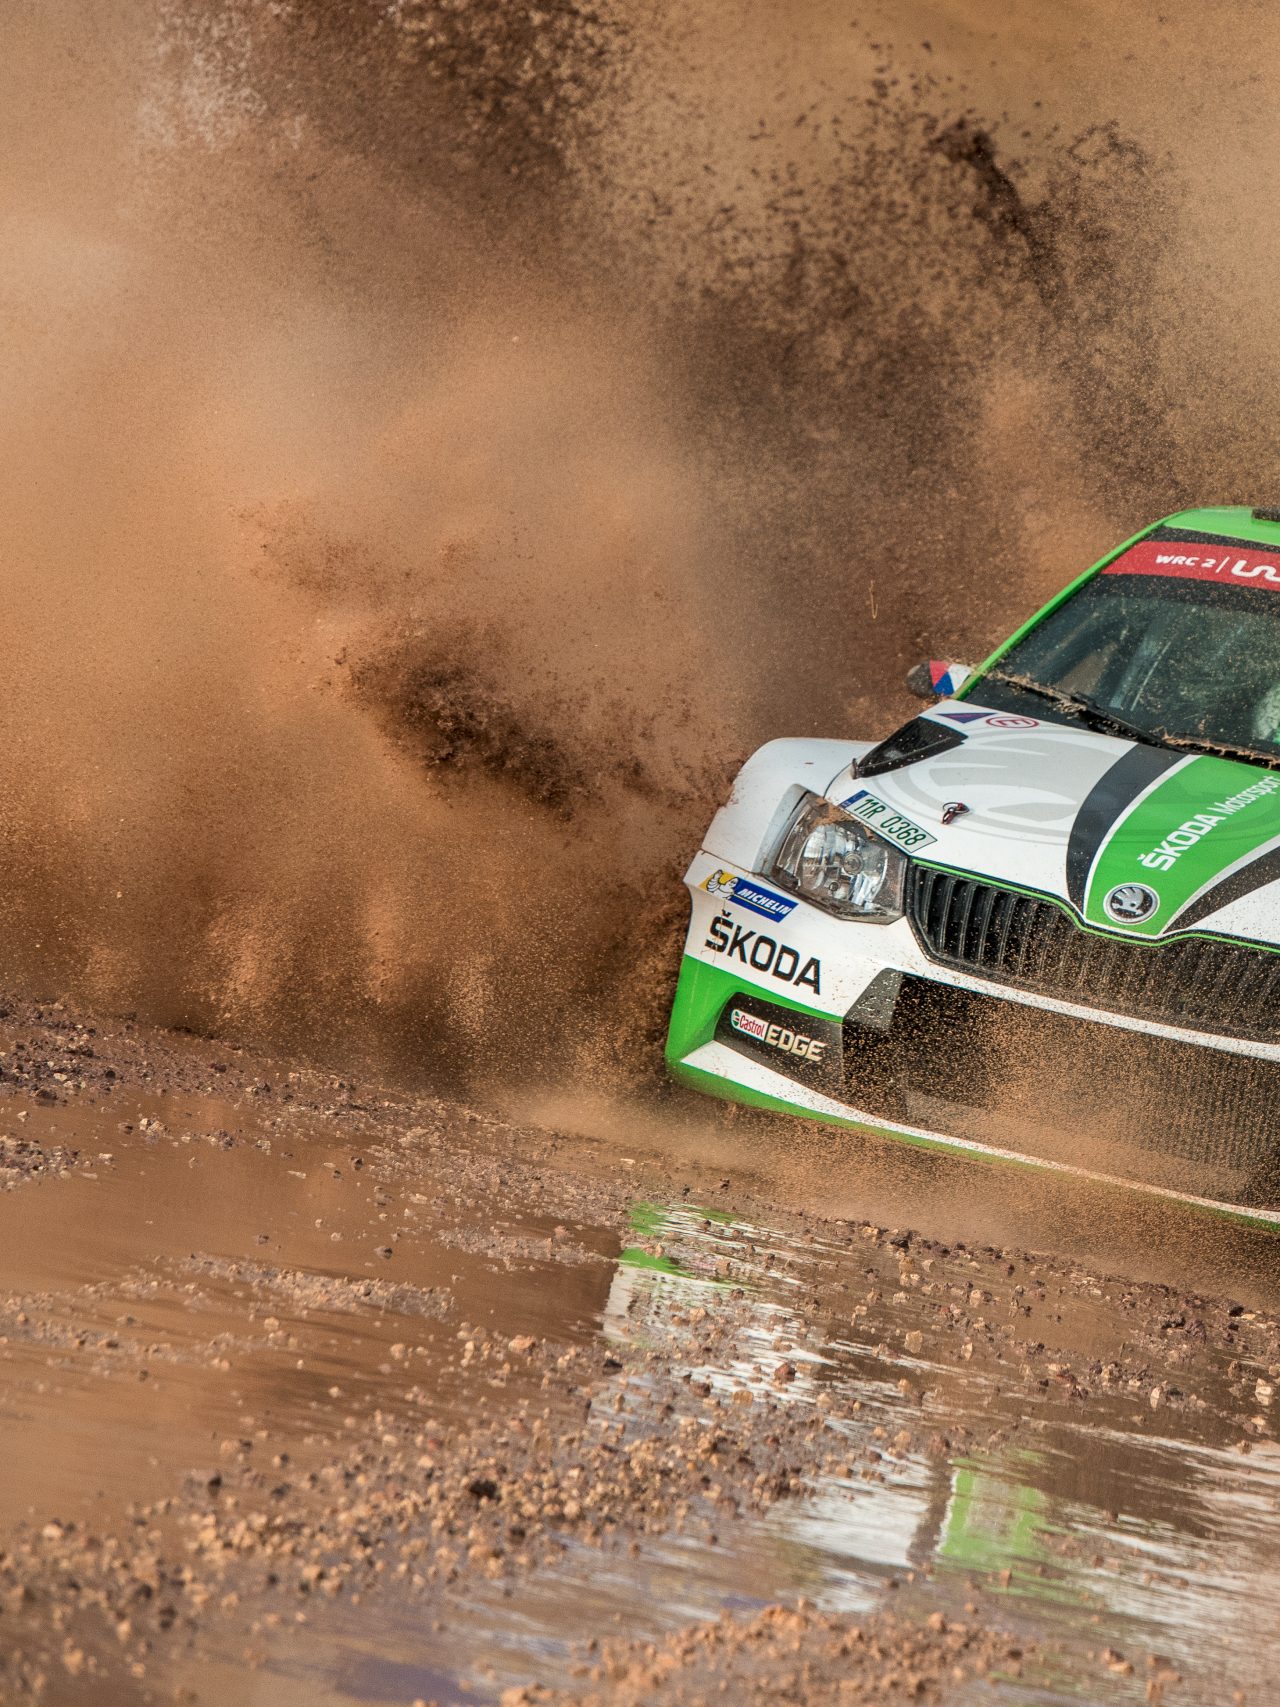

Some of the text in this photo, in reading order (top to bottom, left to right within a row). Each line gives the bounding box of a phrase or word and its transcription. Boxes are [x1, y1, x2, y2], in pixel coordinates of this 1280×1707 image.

[1155, 554, 1200, 567] WRC
[1201, 558, 1217, 568] 2
[854, 798, 927, 846] 11R 0368
[1137, 813, 1227, 871] ŠKODA
[737, 887, 794, 914] MICHELIN
[704, 909, 821, 996] ŠKODA
[739, 1014, 829, 1062] Castrol EDGE
